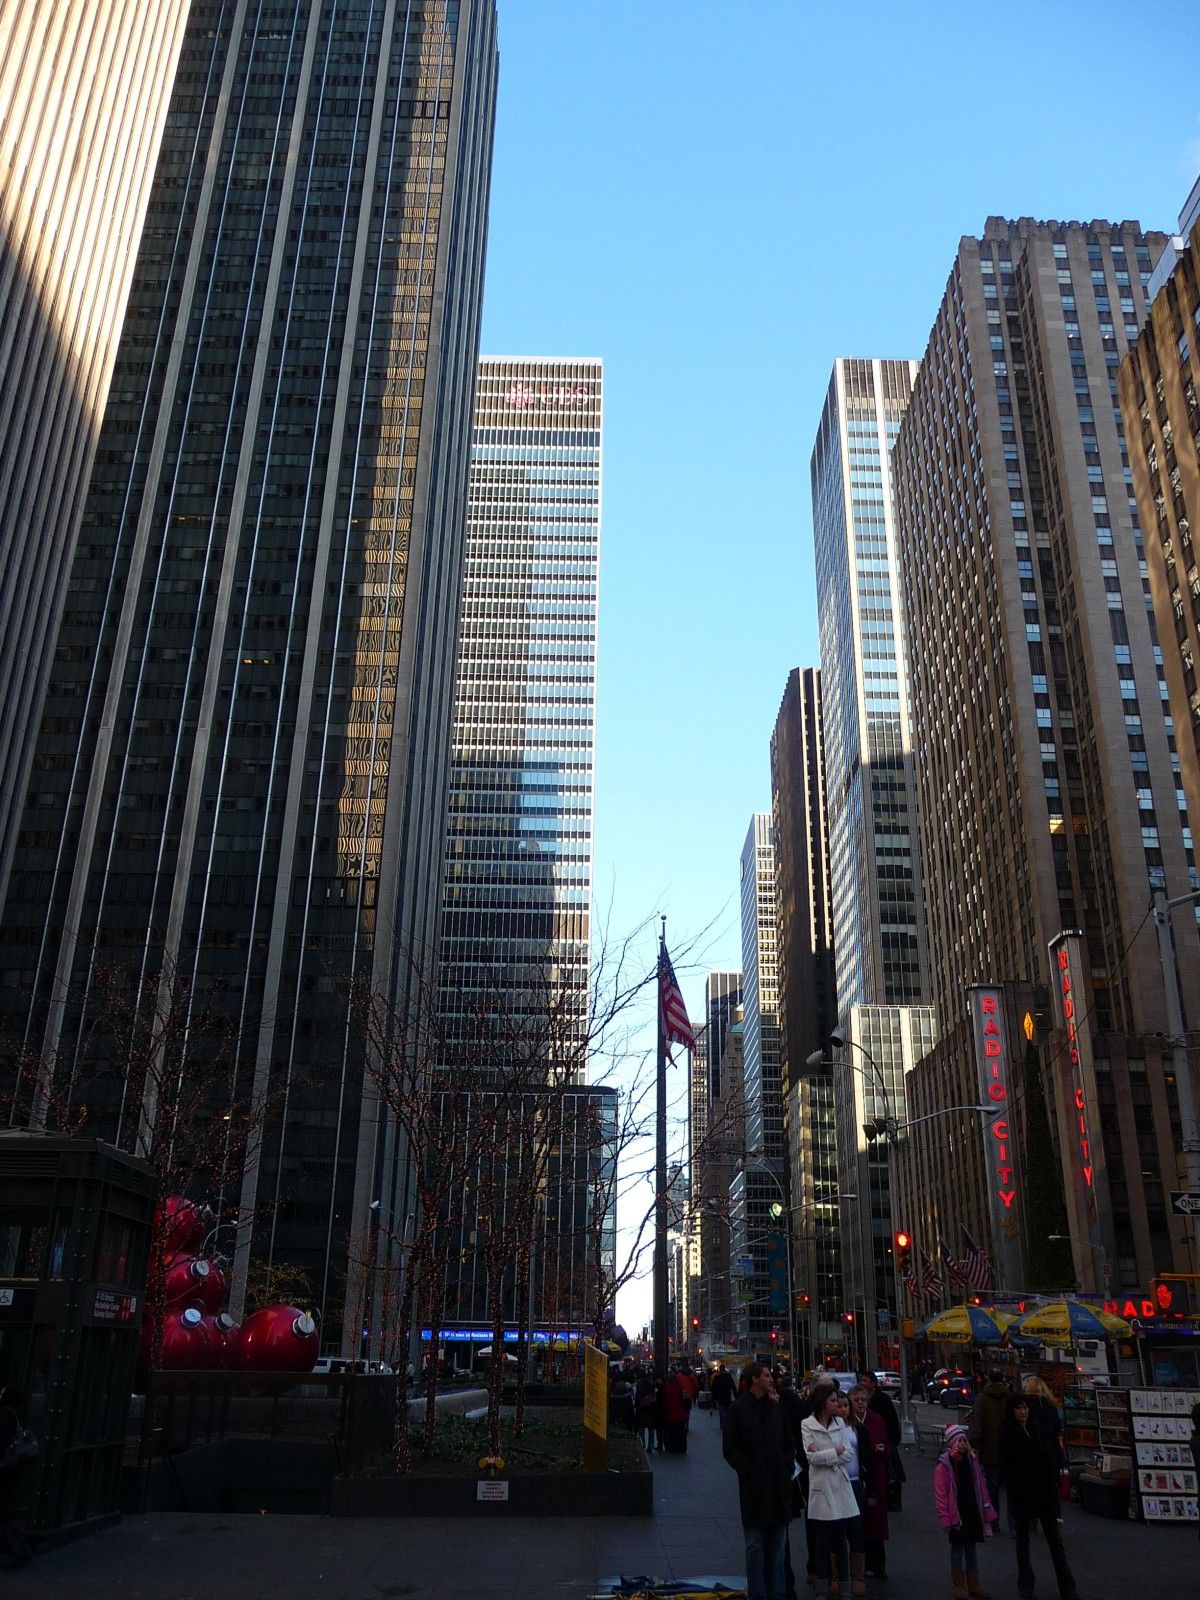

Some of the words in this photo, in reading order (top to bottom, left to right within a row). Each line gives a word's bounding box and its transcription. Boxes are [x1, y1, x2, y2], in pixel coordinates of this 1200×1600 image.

[981, 996, 1006, 1102] RADIO
[1058, 949, 1079, 1066] RADIO
[1075, 1088, 1093, 1188] CITY
[992, 1120, 1015, 1210] CITY
